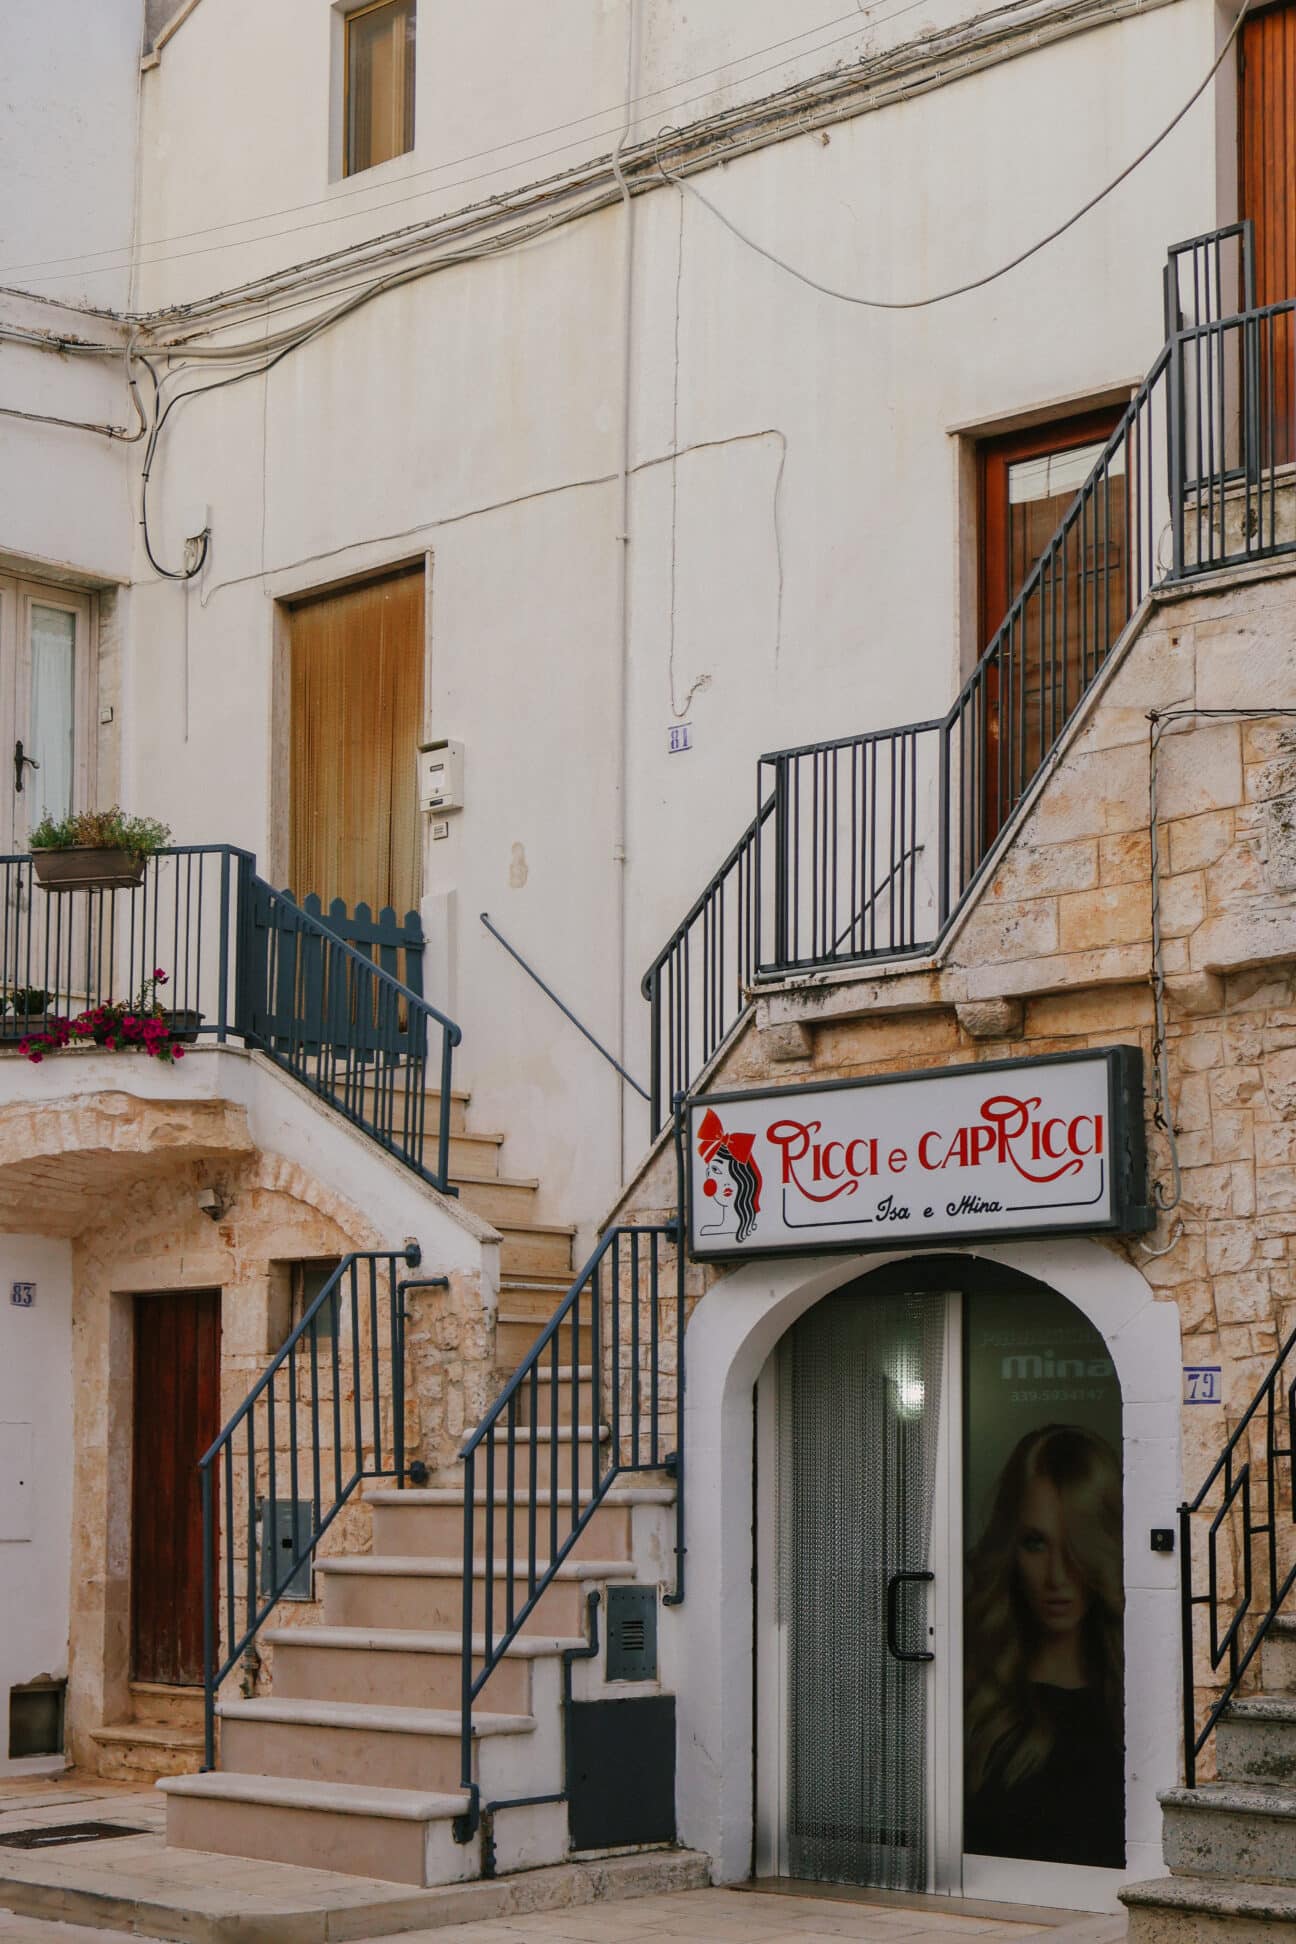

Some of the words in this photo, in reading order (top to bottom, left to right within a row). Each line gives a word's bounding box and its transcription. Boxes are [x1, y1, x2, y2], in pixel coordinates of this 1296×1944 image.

[671, 727, 688, 749] 81
[766, 1119, 879, 1203] RICCI
[888, 1148, 908, 1174] e
[917, 1095, 1104, 1183] CAPRICCI
[875, 1194, 911, 1222] Isa
[923, 1206, 935, 1218] e
[946, 1195, 1003, 1217] Mina
[13, 1285, 33, 1304] 83
[1187, 1373, 1214, 1399] 79
